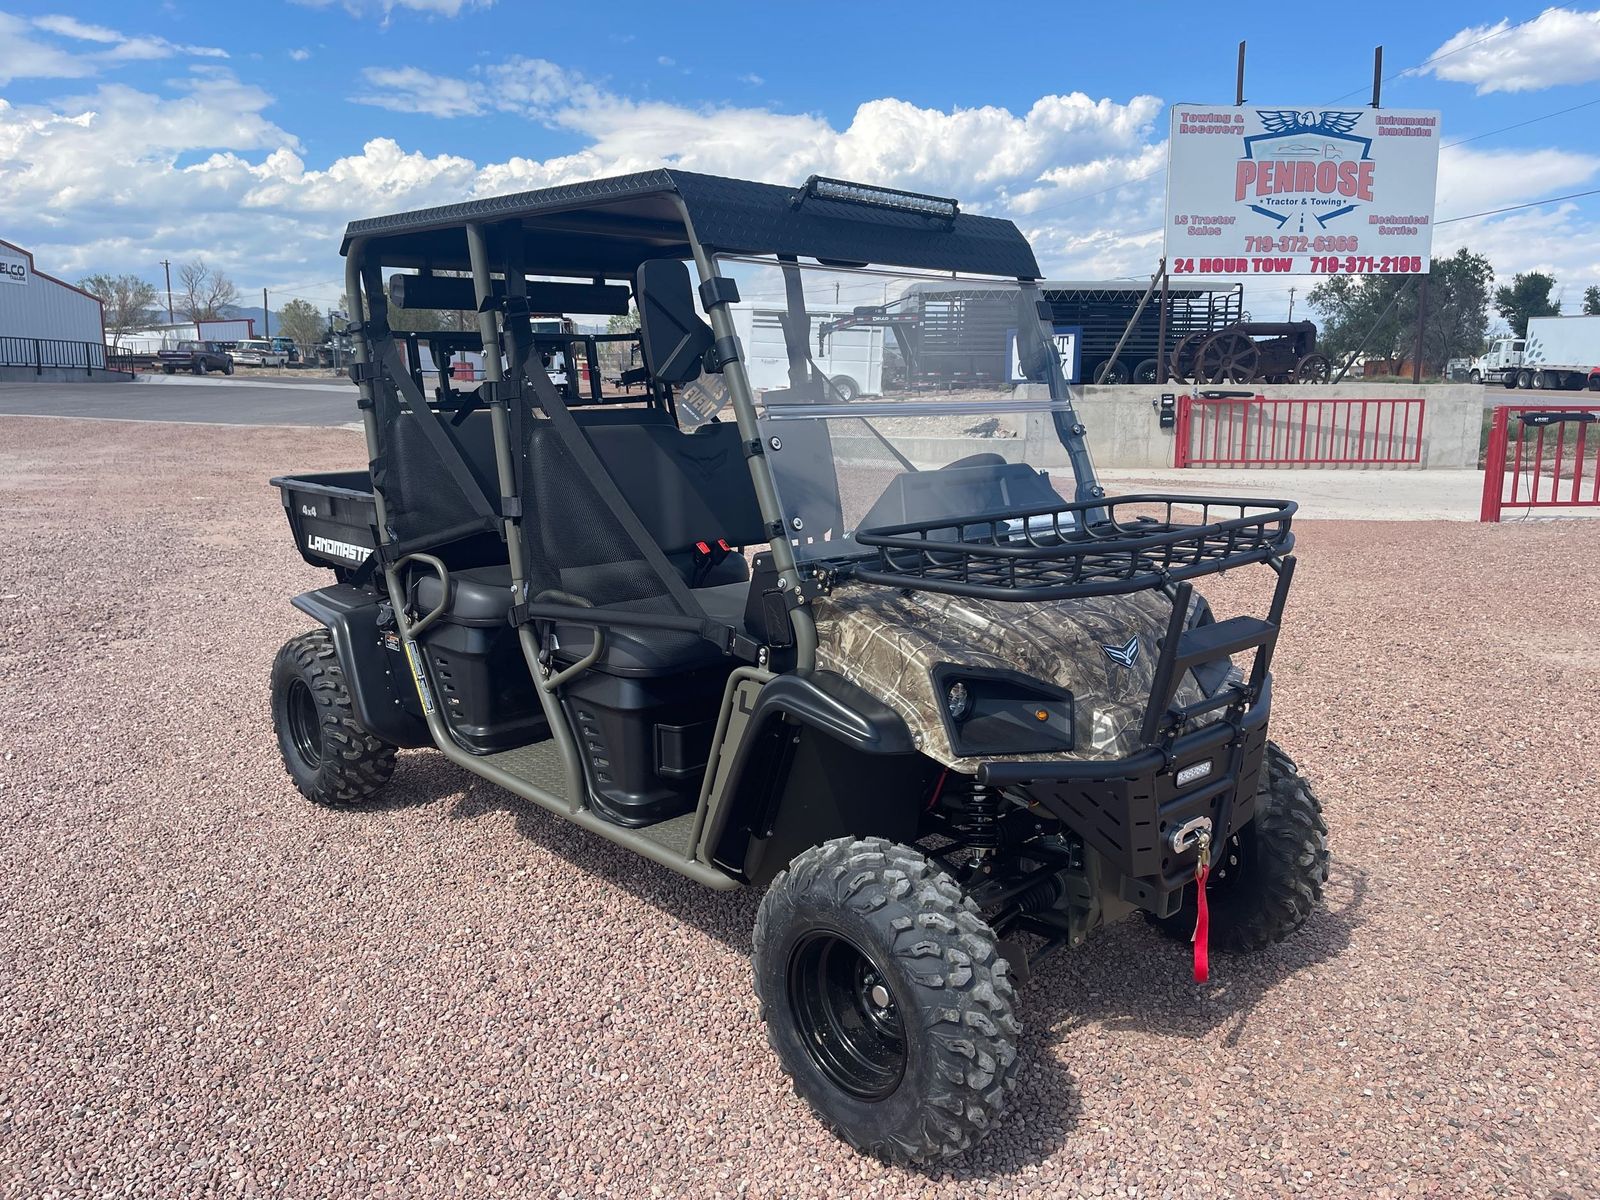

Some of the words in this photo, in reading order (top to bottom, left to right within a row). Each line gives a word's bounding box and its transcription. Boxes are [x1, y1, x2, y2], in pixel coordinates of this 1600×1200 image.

[1181, 113, 1231, 124] Towing
[1234, 114, 1244, 123] &
[1375, 115, 1436, 126] Environmental
[1180, 124, 1245, 135] Recovery
[1378, 126, 1432, 137] Remediation
[1235, 161, 1375, 202] PENROSE
[1265, 198, 1298, 206] Tractor
[1311, 198, 1342, 206] Towing
[1174, 215, 1188, 225] LS
[1190, 215, 1236, 225] Tractor
[1368, 215, 1429, 224] Mechanical
[1187, 226, 1222, 236] Sales
[1378, 226, 1418, 235] Service
[1244, 235, 1359, 252] 719-372-6366
[1174, 258, 1195, 273] 24
[1199, 258, 1248, 273] HOUR
[1251, 258, 1294, 272] TOW
[1310, 256, 1422, 273] 719-371-2195
[302, 505, 317, 517] 4x4
[308, 534, 375, 563] LANDMASTE
